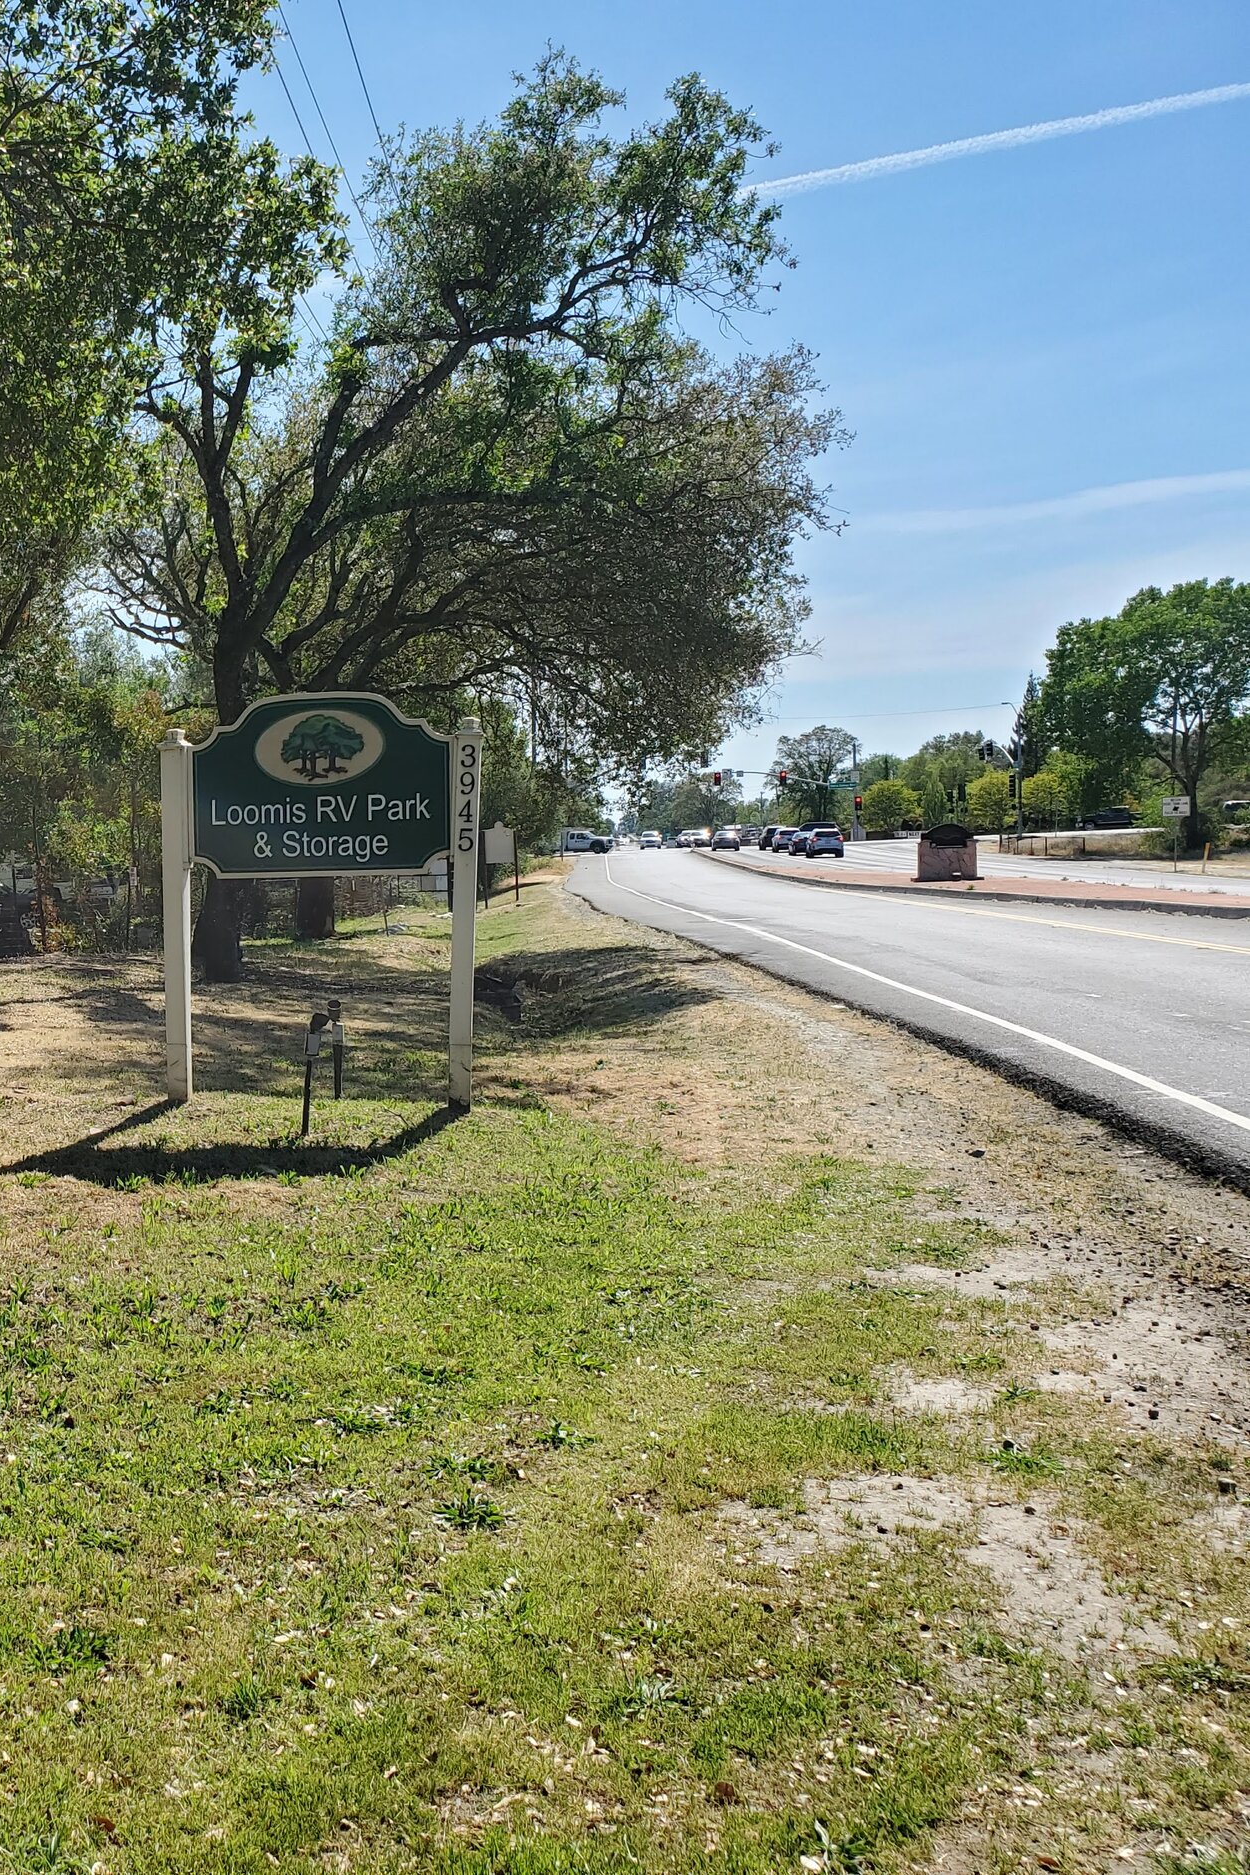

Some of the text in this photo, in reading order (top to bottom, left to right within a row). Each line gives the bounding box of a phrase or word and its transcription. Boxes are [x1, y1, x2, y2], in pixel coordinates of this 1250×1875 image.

[211, 792, 431, 826] Loomis RV Park
[458, 744, 476, 851] 3945
[253, 830, 389, 863] & Storage
